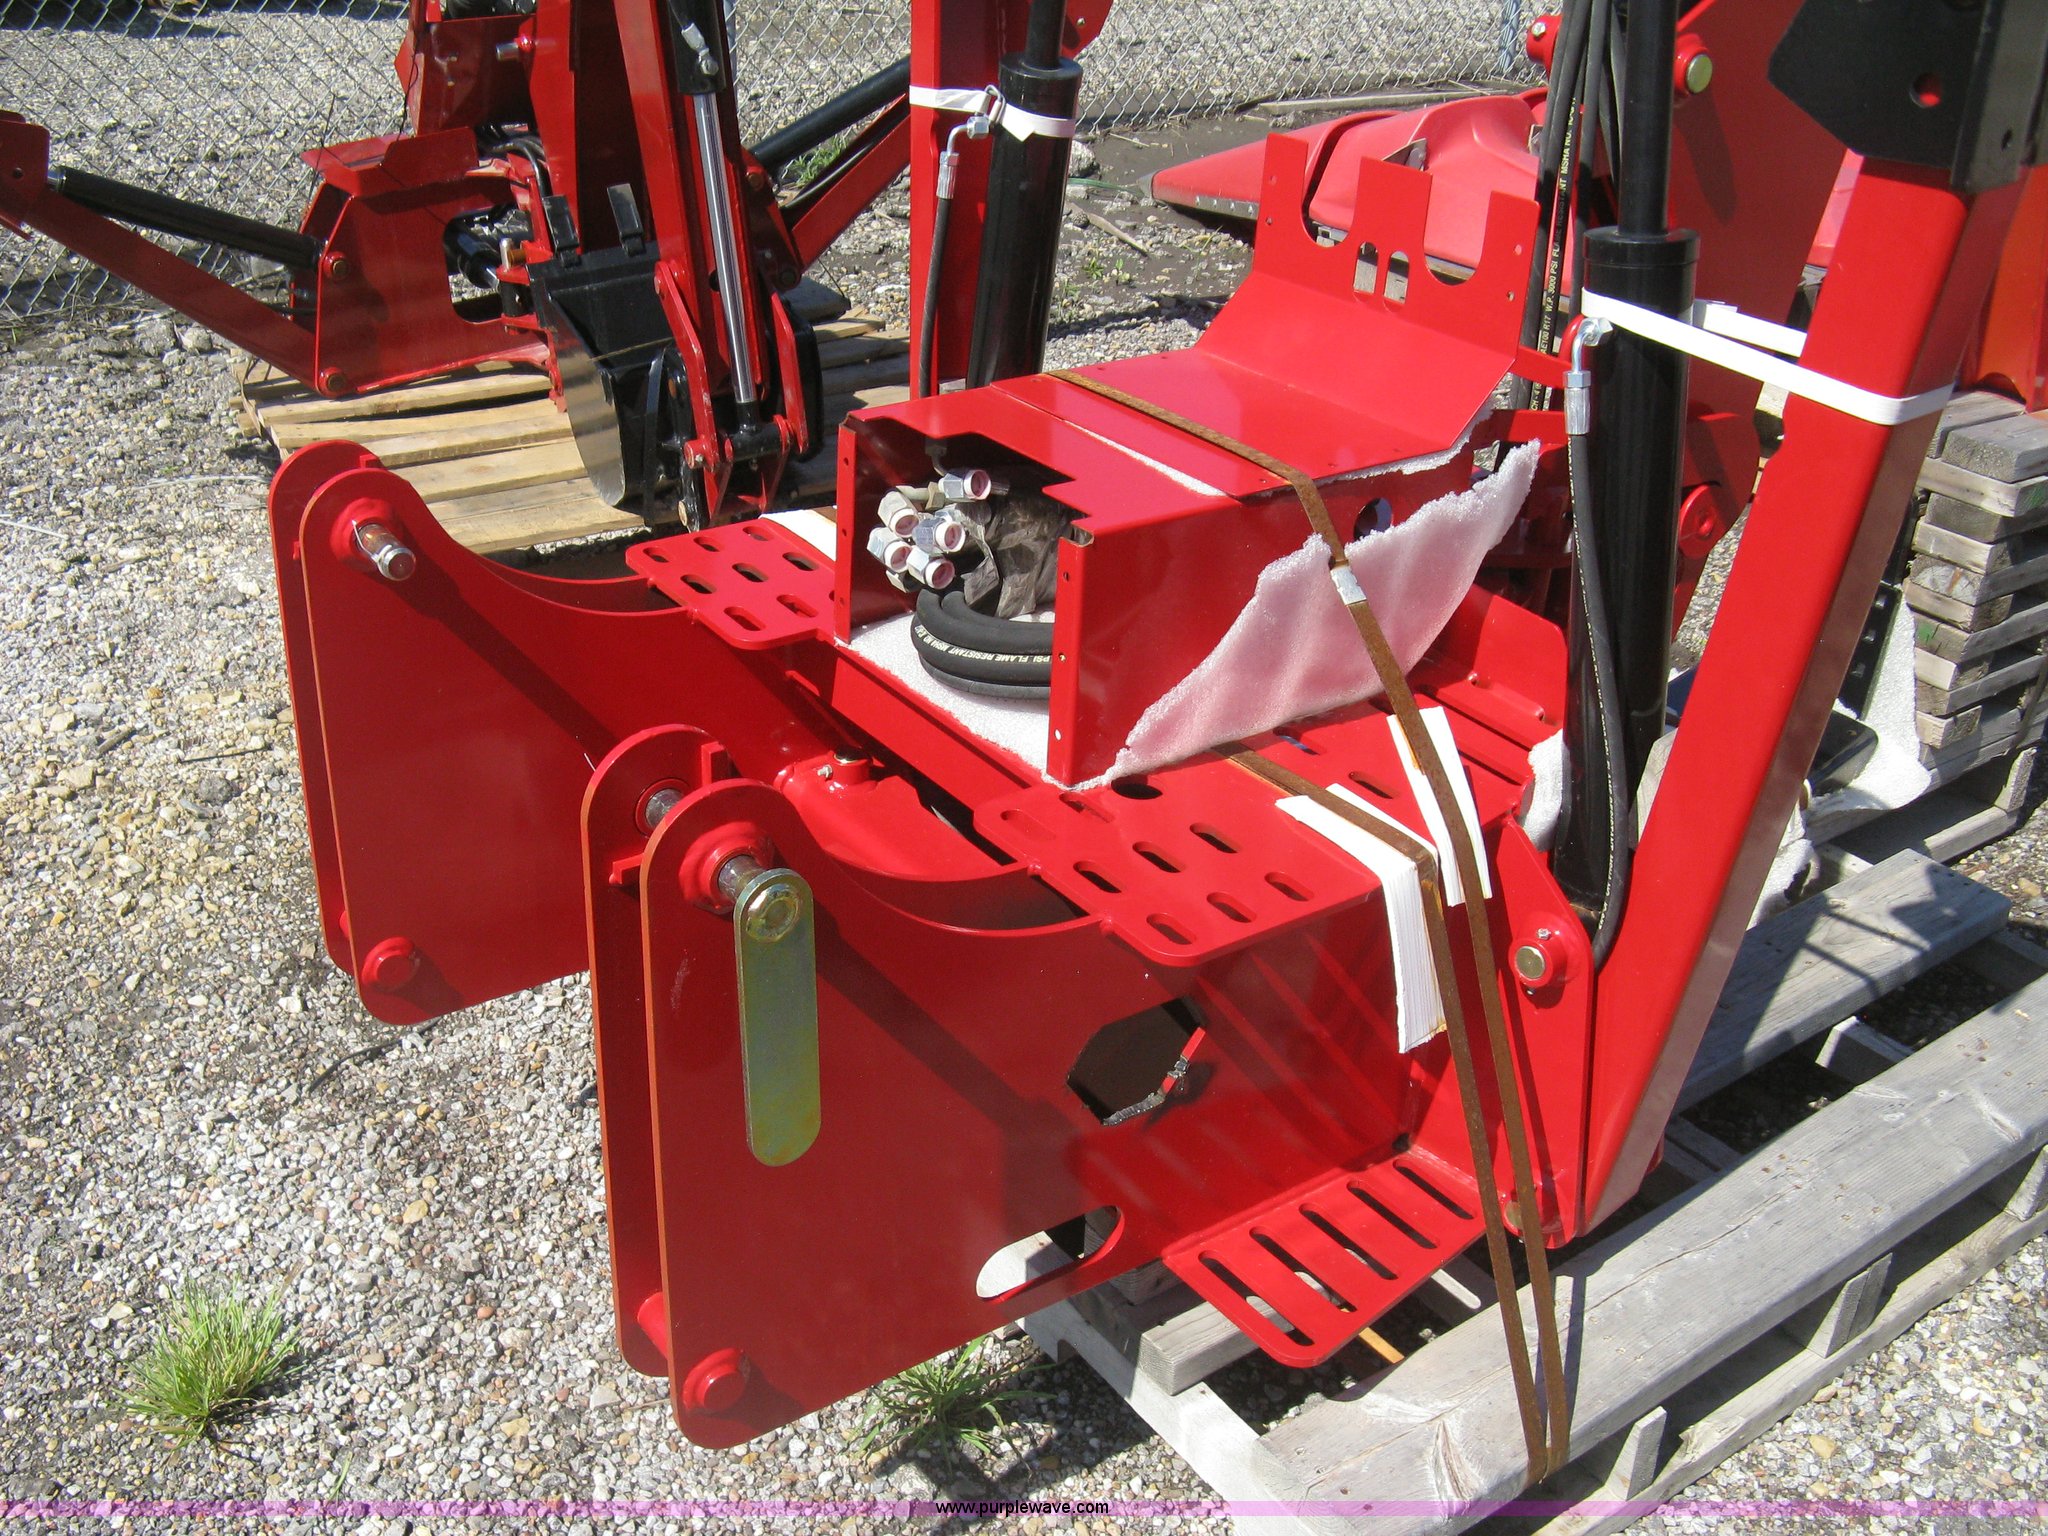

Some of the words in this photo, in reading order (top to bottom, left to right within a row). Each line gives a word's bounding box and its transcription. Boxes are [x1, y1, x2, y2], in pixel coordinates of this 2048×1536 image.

[1550, 260, 1559, 275] PSI
[1560, 147, 1570, 175] MSHA
[948, 646, 994, 661] RESISTANT
[996, 654, 1030, 663] FLAME
